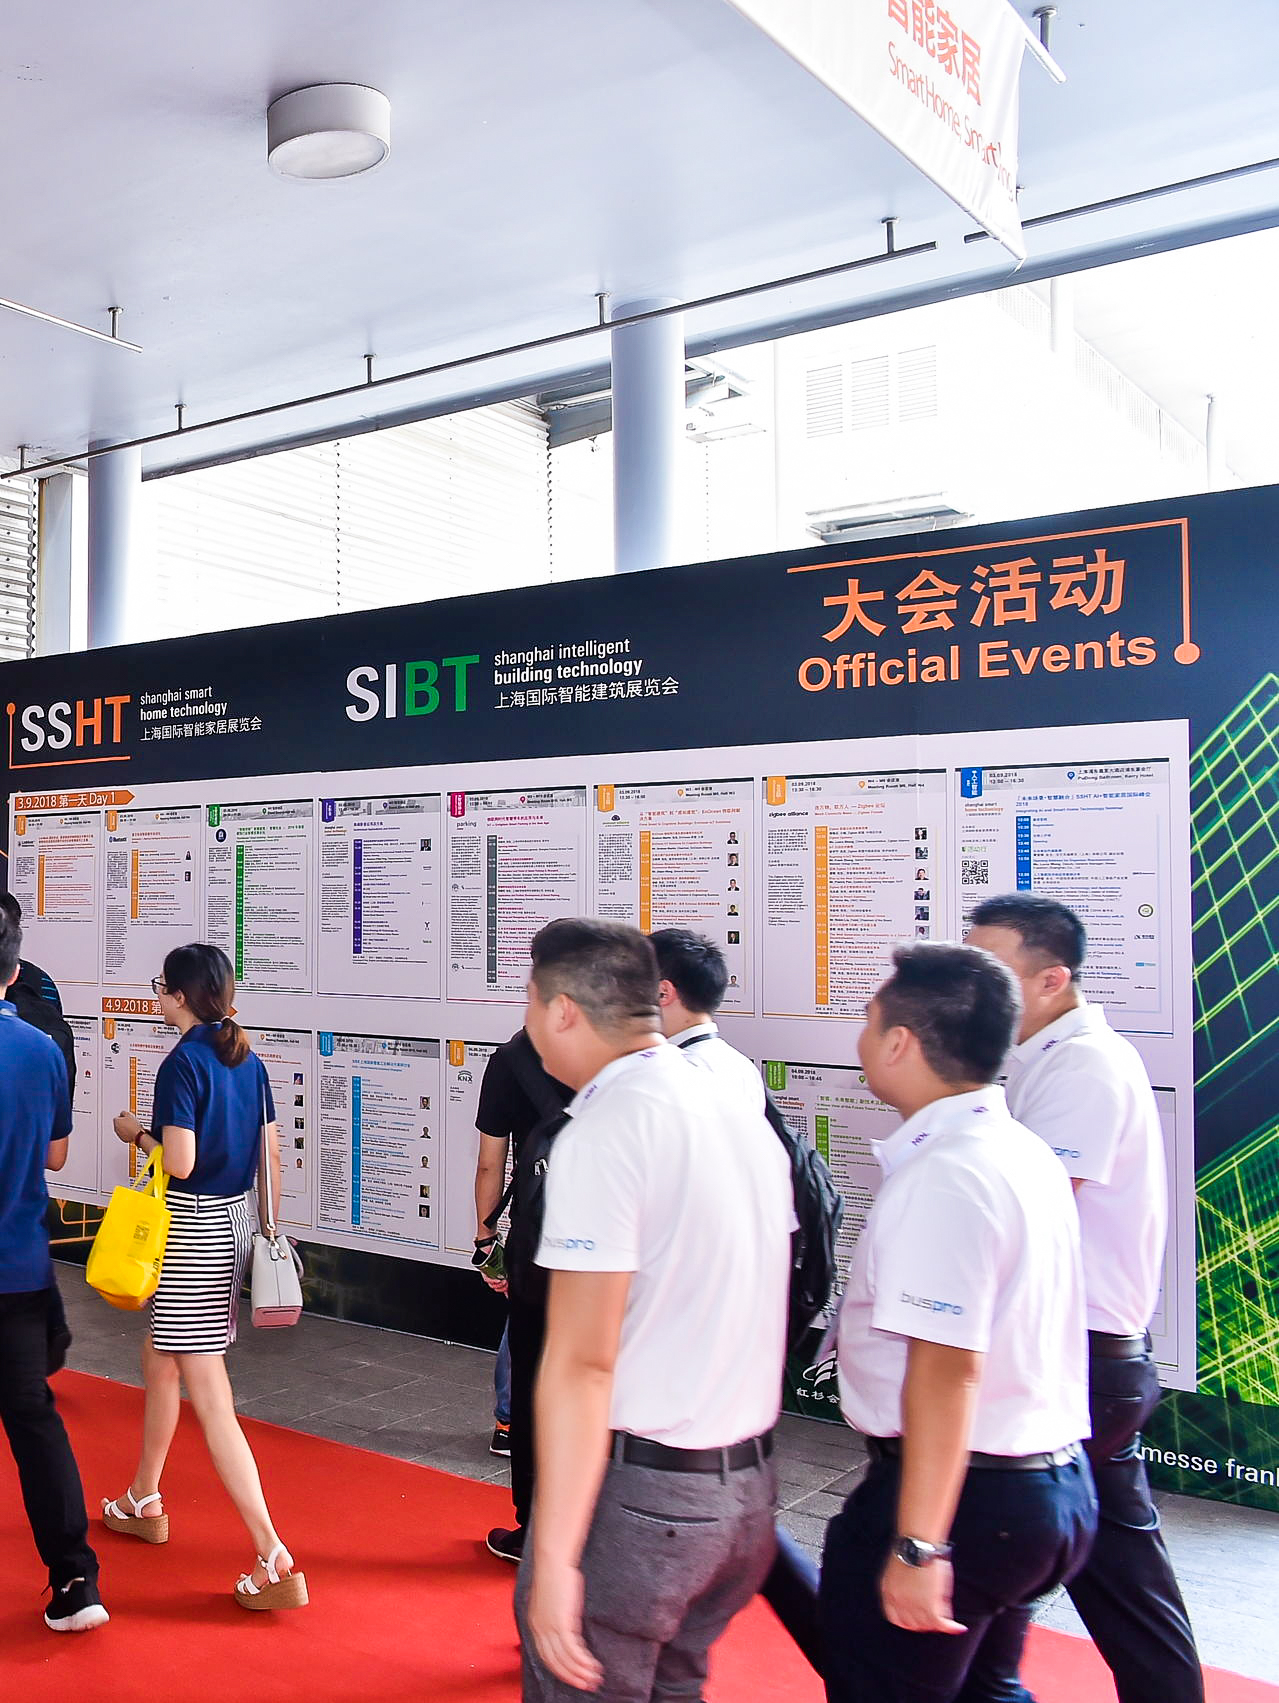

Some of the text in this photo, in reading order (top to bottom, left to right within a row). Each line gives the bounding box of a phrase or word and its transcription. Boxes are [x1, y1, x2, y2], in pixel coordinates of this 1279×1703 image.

[888, 40, 925, 106] Smart
[822, 548, 1126, 643] 大会活动
[493, 637, 631, 667] shanghai intelligent
[797, 630, 1158, 693] Official Events
[493, 658, 644, 686] building technology
[139, 685, 214, 706] shanghai smart
[344, 653, 480, 723] SIBT
[493, 675, 681, 710] 上海国际智能建筑展览会
[20, 694, 132, 753] SSHT
[139, 701, 228, 722] home technology
[139, 715, 263, 742] 上海国际智能家居展览会
[17, 791, 116, 810] 3.9.2018 第一天 Day 1
[456, 820, 477, 828] parking
[105, 999, 165, 1015] 4.9.2018 第
[900, 1290, 964, 1317] buspro
[1140, 1445, 1279, 1488] messe fran
